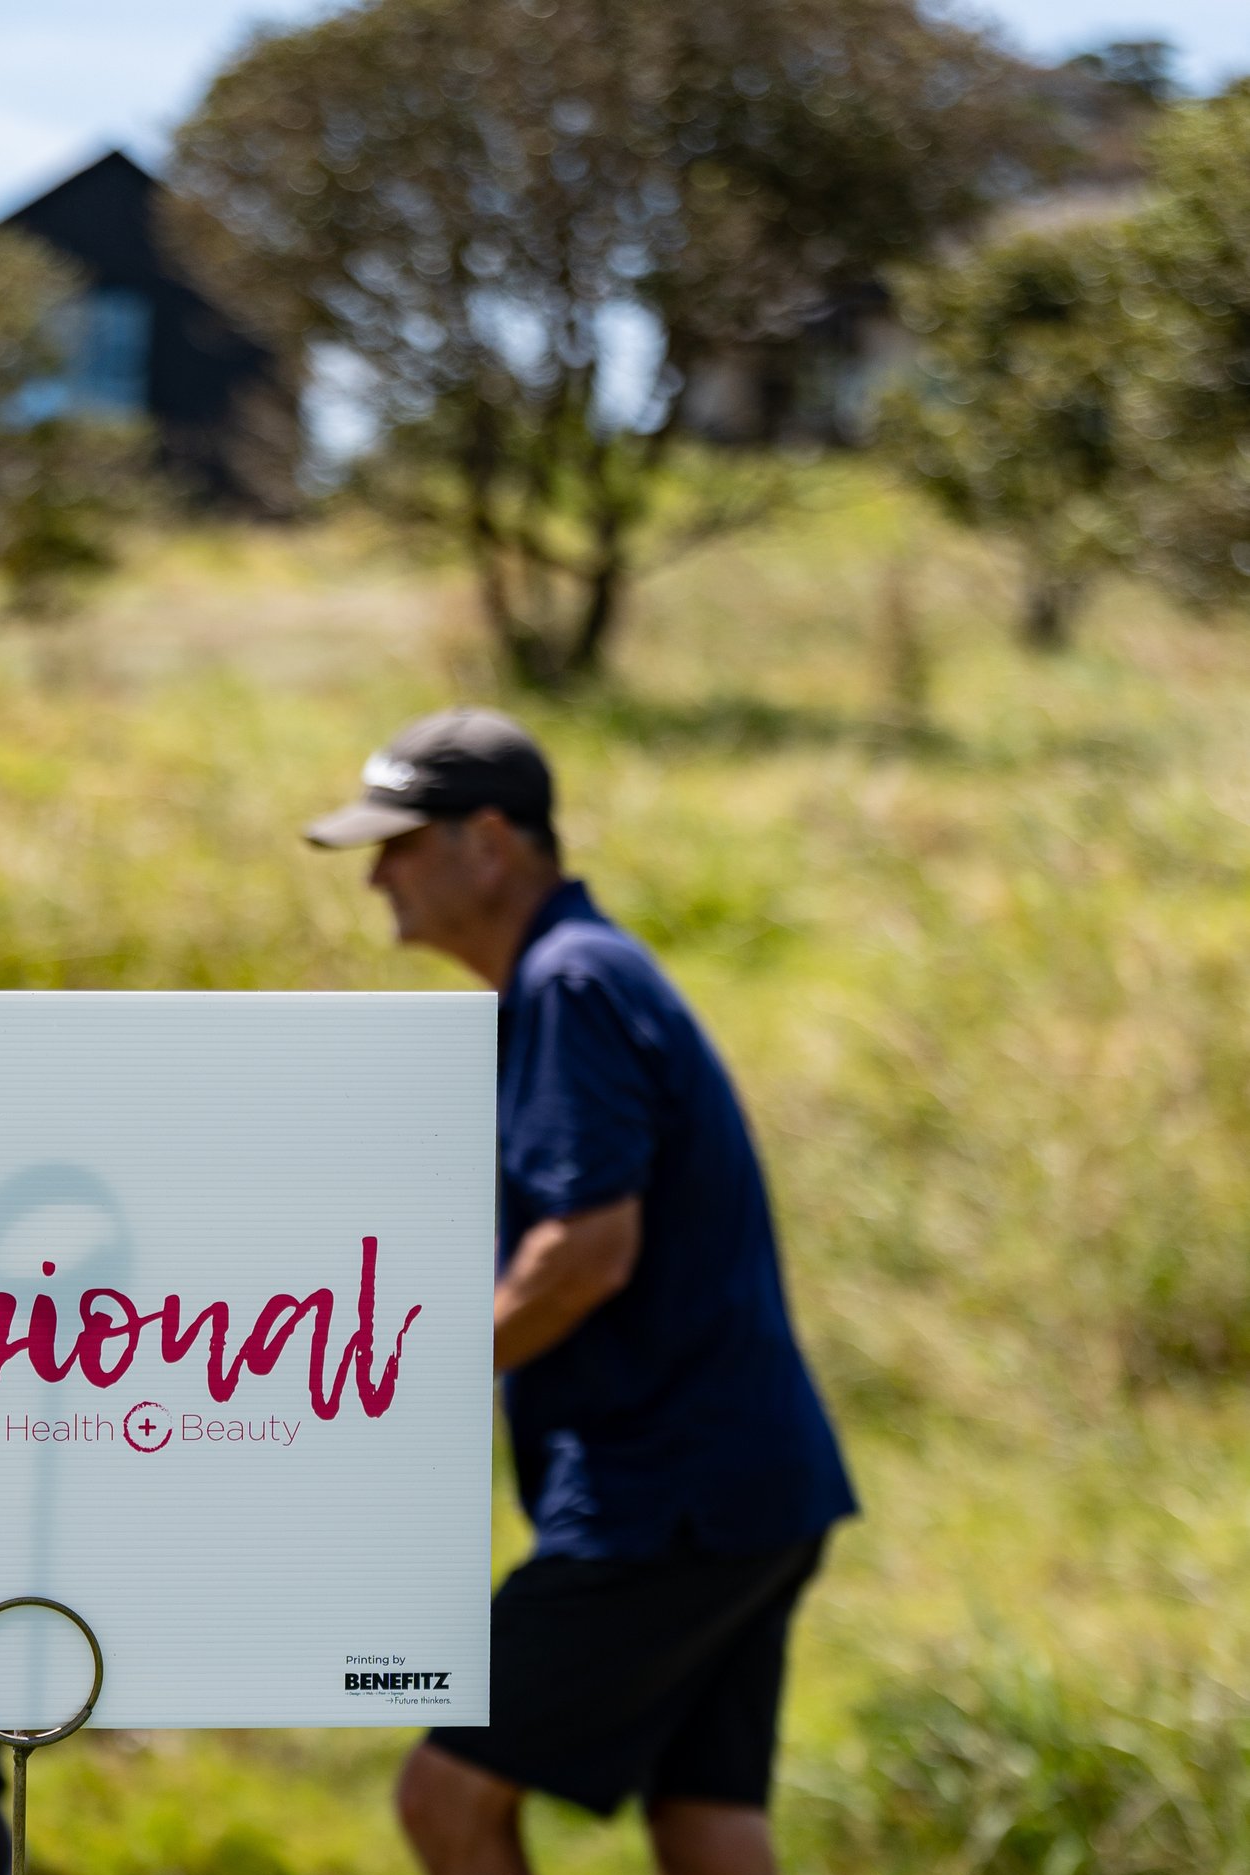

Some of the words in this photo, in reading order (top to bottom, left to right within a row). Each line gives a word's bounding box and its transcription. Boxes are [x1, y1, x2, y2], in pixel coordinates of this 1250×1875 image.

[5, 1410, 115, 1442] Health
[181, 1412, 301, 1446] Beauty
[346, 1655, 390, 1666] Printing
[392, 1655, 406, 1666] by
[344, 1672, 451, 1690] BENEFITZ
[394, 1696, 419, 1705] Future
[421, 1696, 452, 1705] thinkers.
